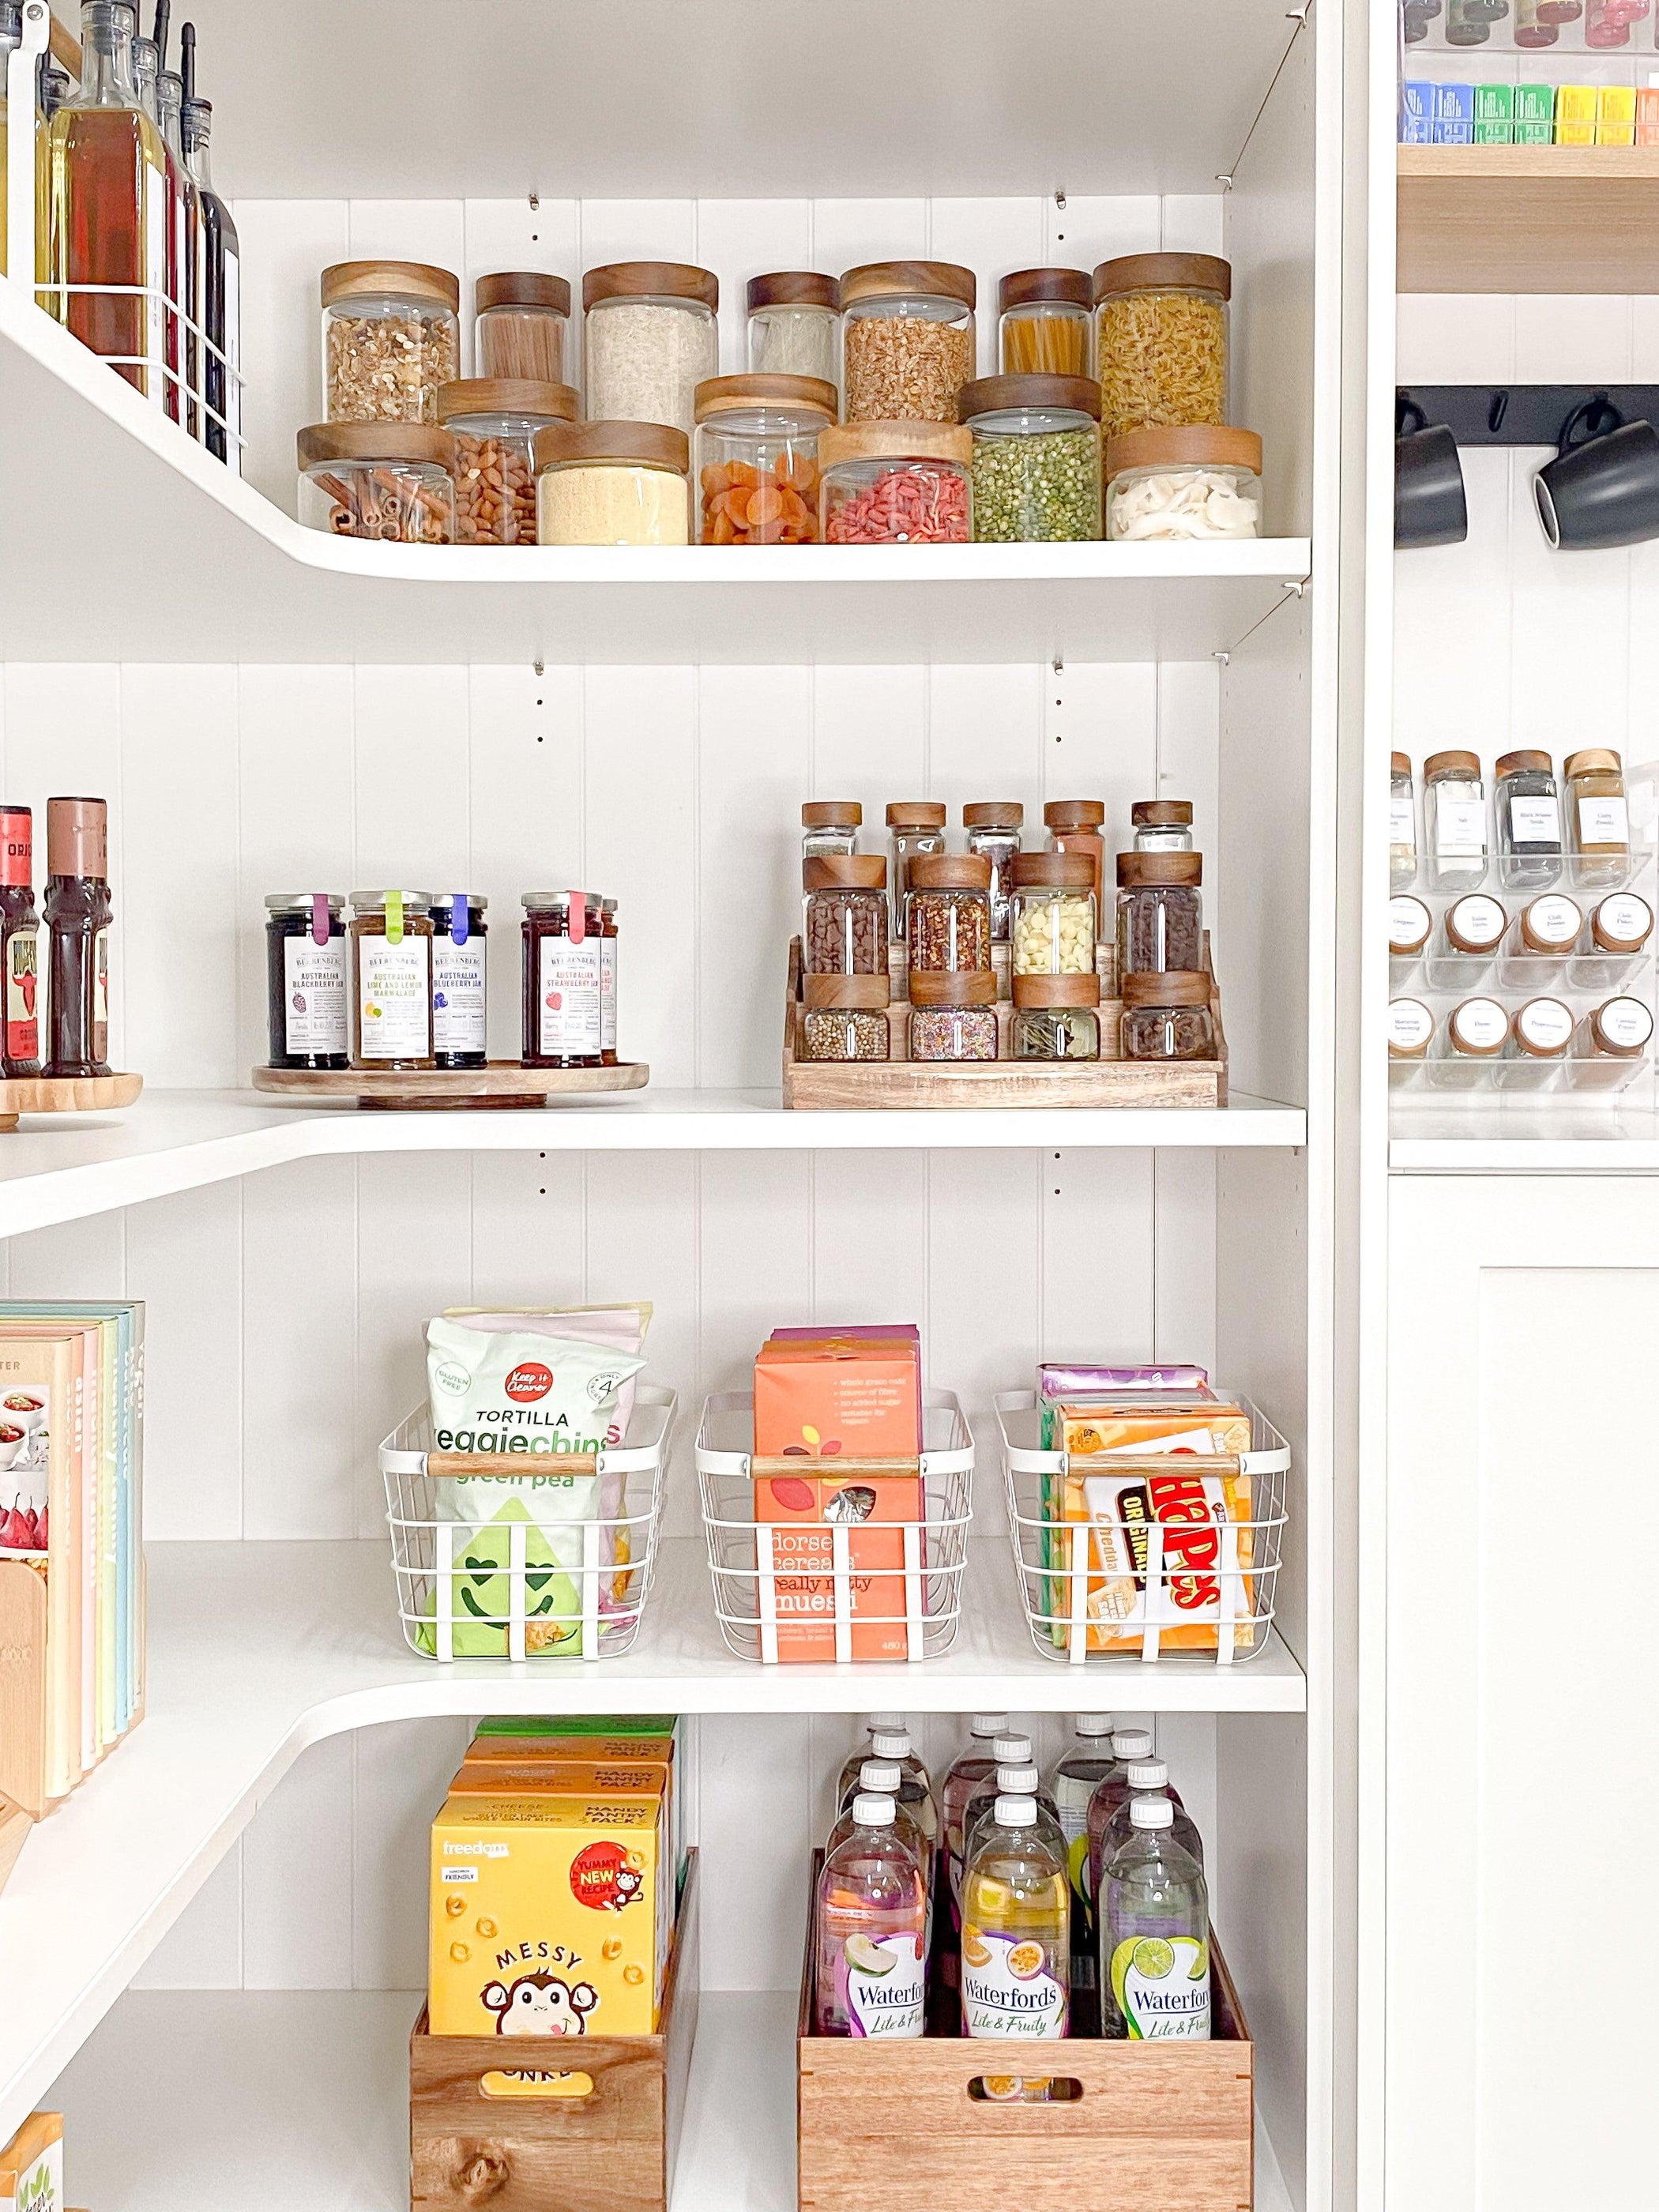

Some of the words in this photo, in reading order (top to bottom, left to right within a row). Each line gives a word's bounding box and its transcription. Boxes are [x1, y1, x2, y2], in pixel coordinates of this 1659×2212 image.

[476, 1409, 570, 1427] TORTILLA
[771, 1532, 833, 1552] dorse
[773, 1555, 856, 1571] cereas
[775, 1591, 859, 1612] muesi
[577, 1858, 617, 1871] YUMMY
[580, 1869, 614, 1886] NEW
[581, 1884, 615, 1895] RECIPE
[495, 1942, 583, 1970] MESSY
[965, 1976, 1056, 2009] Waterfords
[870, 2015, 897, 2034] Lite
[897, 2015, 906, 2028] &
[972, 2009, 992, 2029] Lite
[993, 2017, 1003, 2030] &
[1006, 2014, 1047, 2037] Fruity
[1147, 2020, 1175, 2039] Lite
[1176, 2021, 1185, 2033] &
